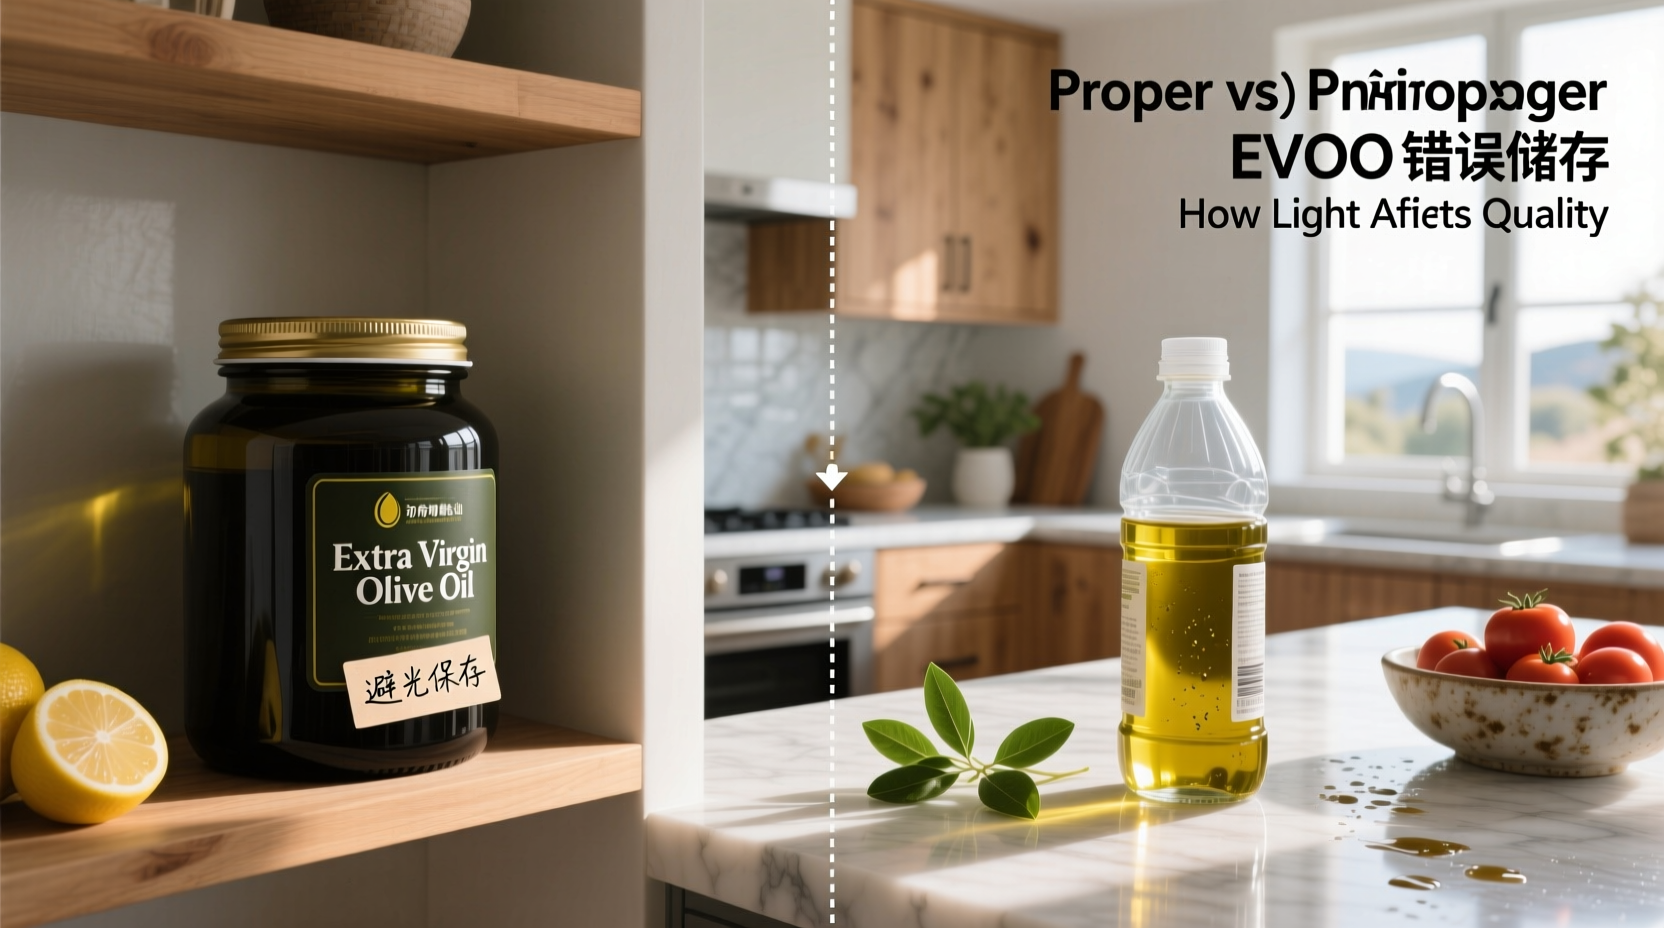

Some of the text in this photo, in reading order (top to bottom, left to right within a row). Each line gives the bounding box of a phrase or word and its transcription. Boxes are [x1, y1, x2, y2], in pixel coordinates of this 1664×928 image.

[332, 537, 488, 573] Extra Virgin
[356, 569, 475, 606] Olive Oil
[364, 653, 487, 705] 避光保存
